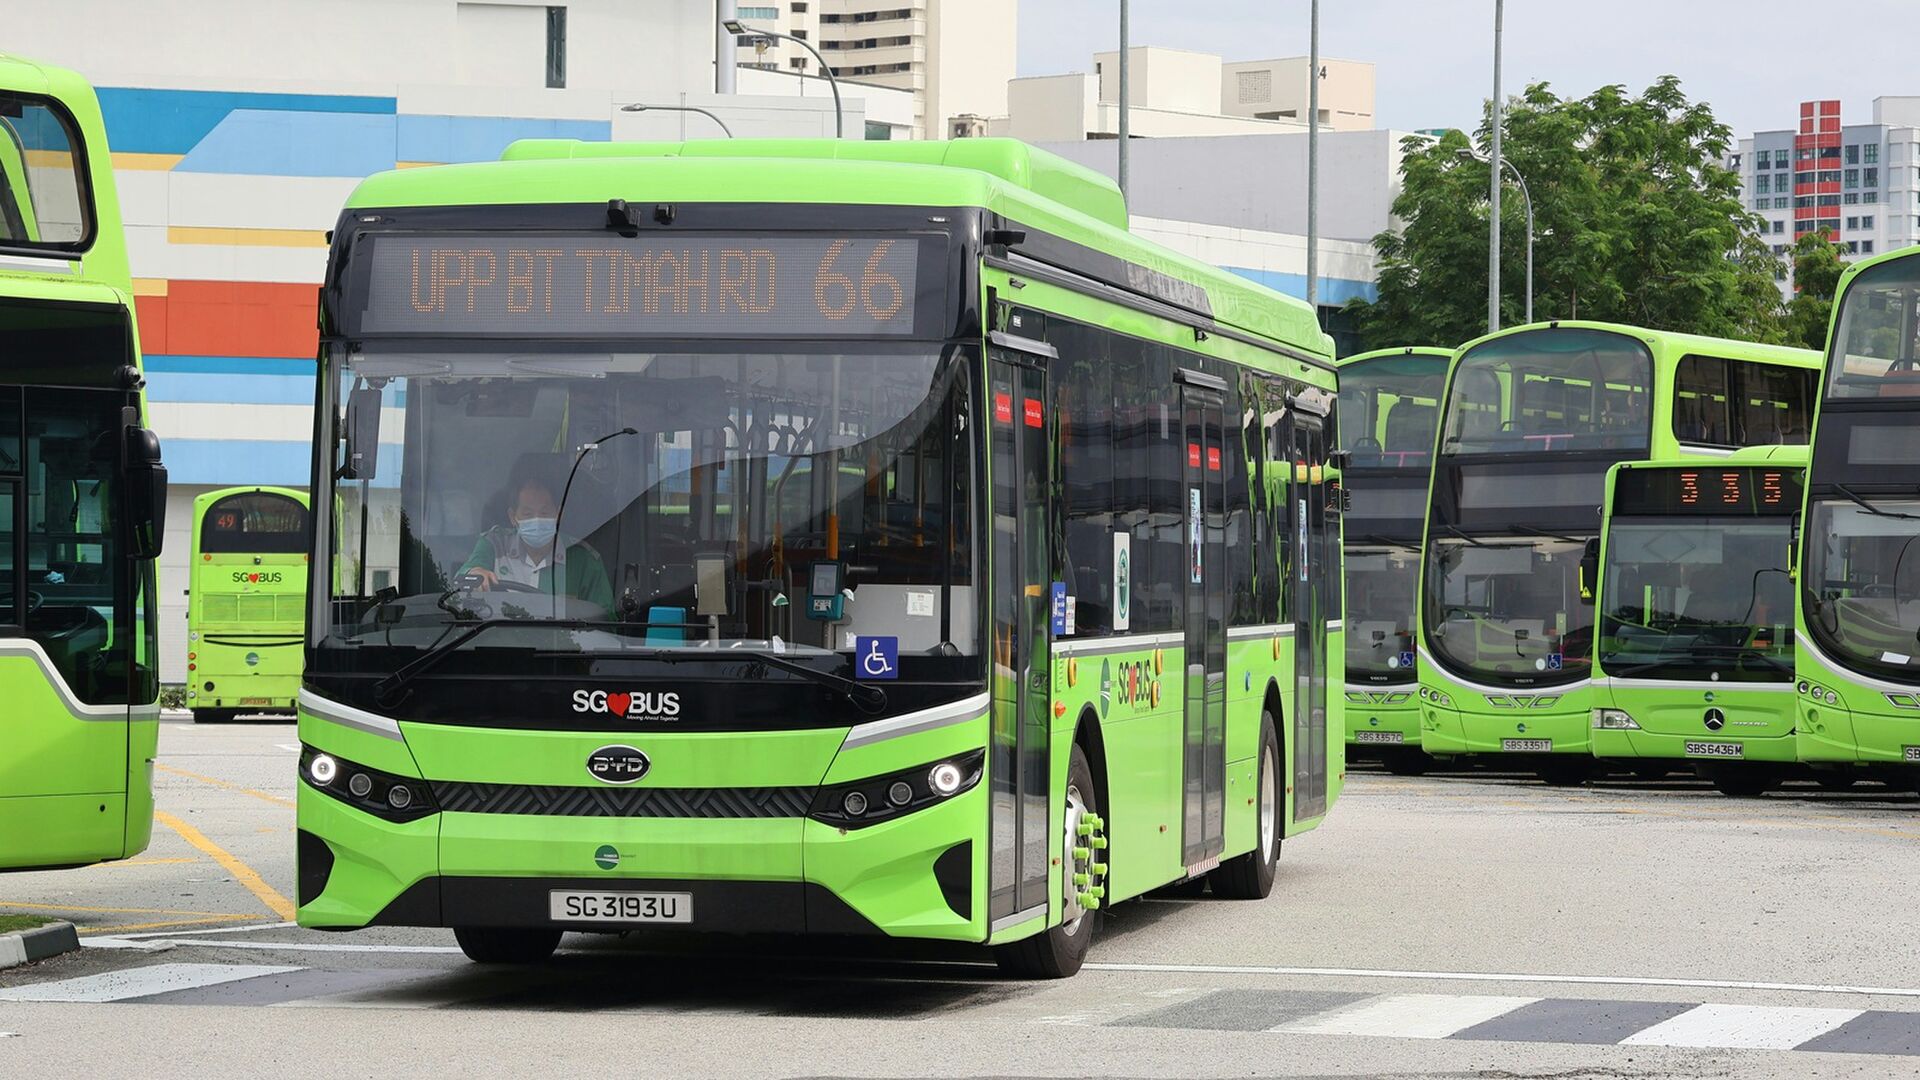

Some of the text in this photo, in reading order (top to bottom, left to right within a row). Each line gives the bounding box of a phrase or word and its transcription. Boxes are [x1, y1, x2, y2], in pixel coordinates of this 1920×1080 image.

[411, 239, 904, 320] UPP BT TIMAH RD 66
[217, 513, 236, 529] 49
[593, 756, 643, 773] BYD
